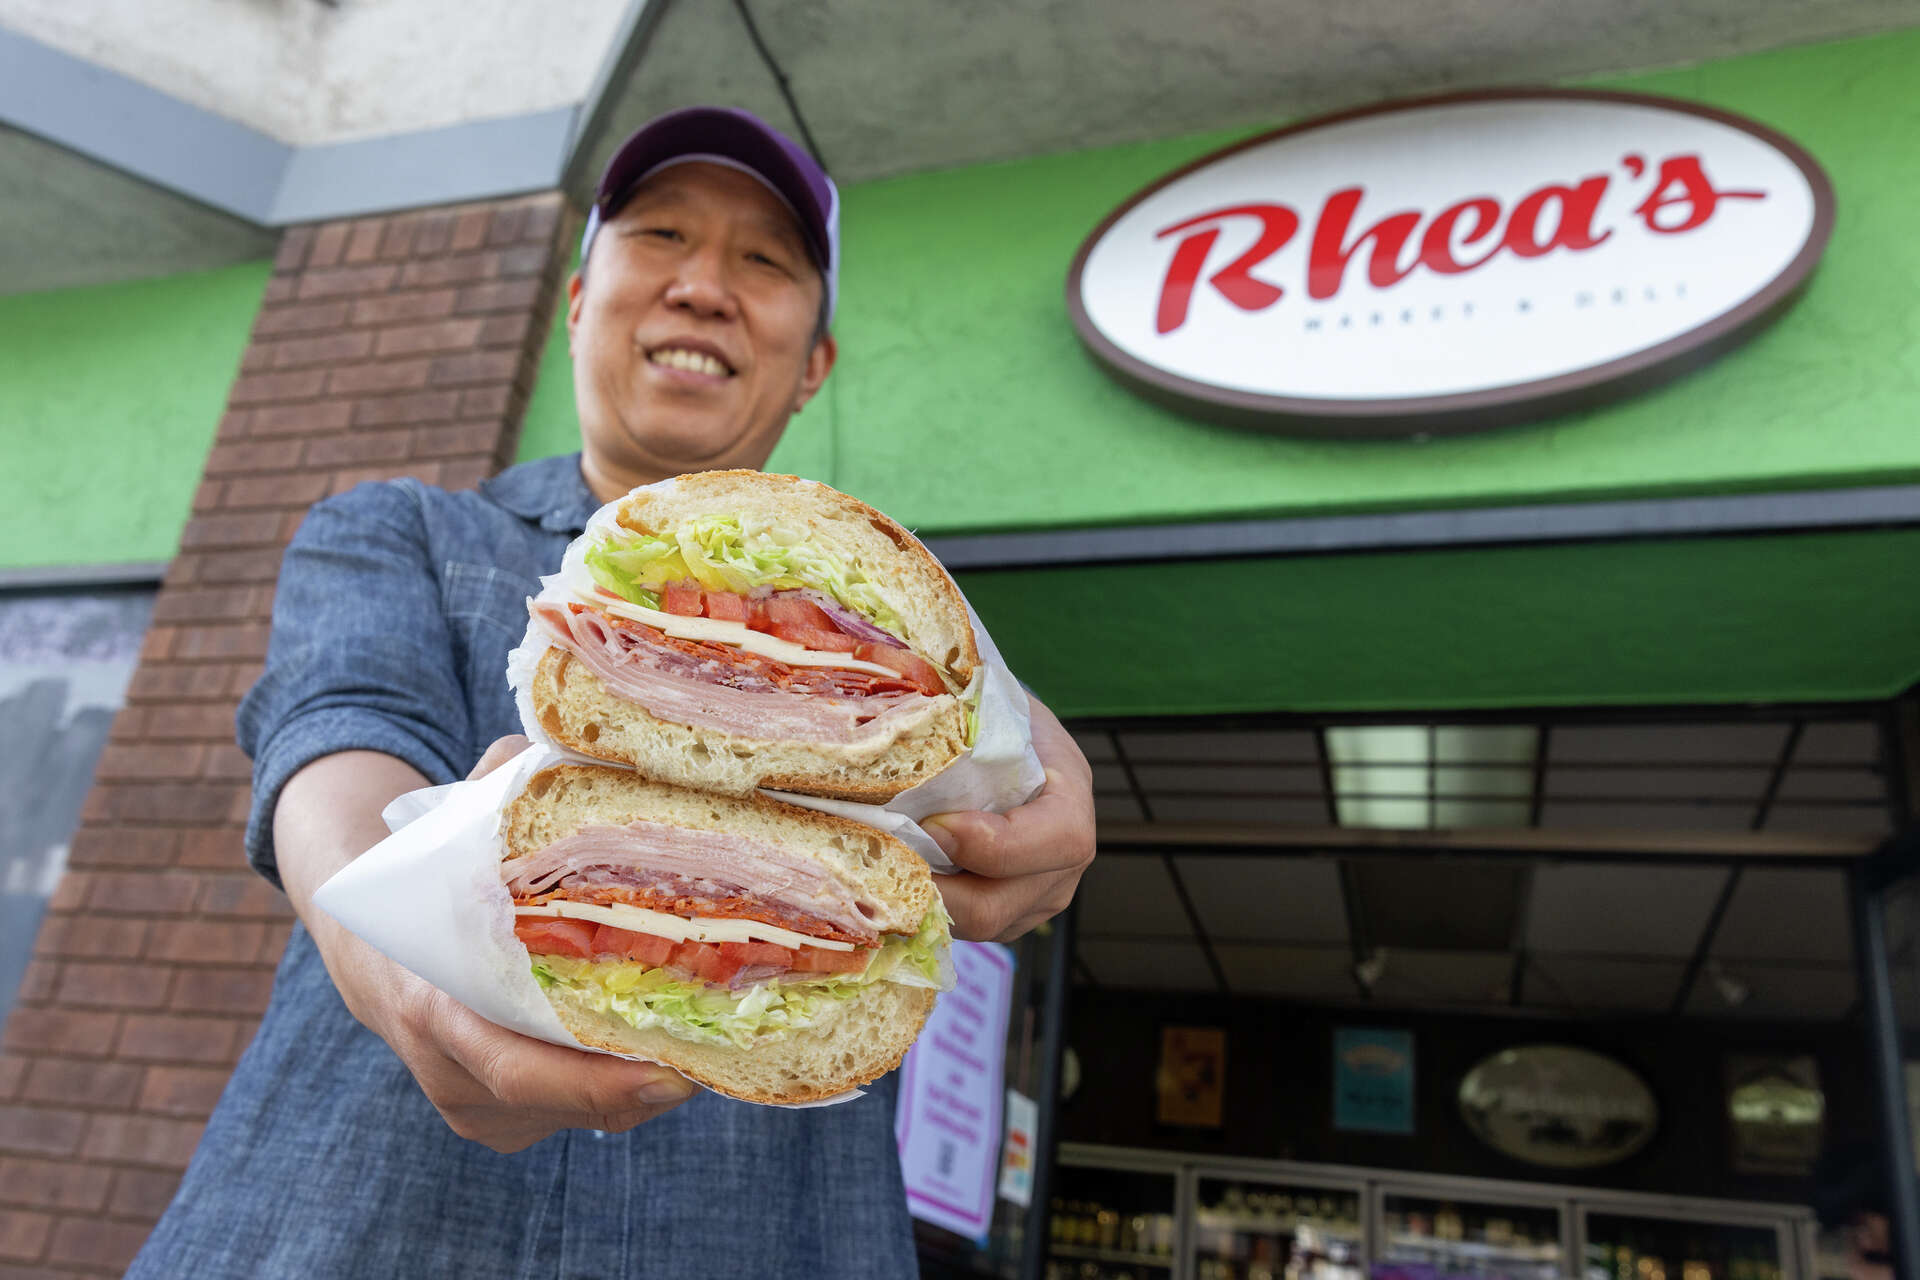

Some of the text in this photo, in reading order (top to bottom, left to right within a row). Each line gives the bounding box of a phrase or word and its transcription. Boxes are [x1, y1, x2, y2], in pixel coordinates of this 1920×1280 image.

[1155, 153, 1767, 335] Rhea's
[1304, 302, 1475, 332] MARKET
[1574, 281, 1688, 309] DELI
